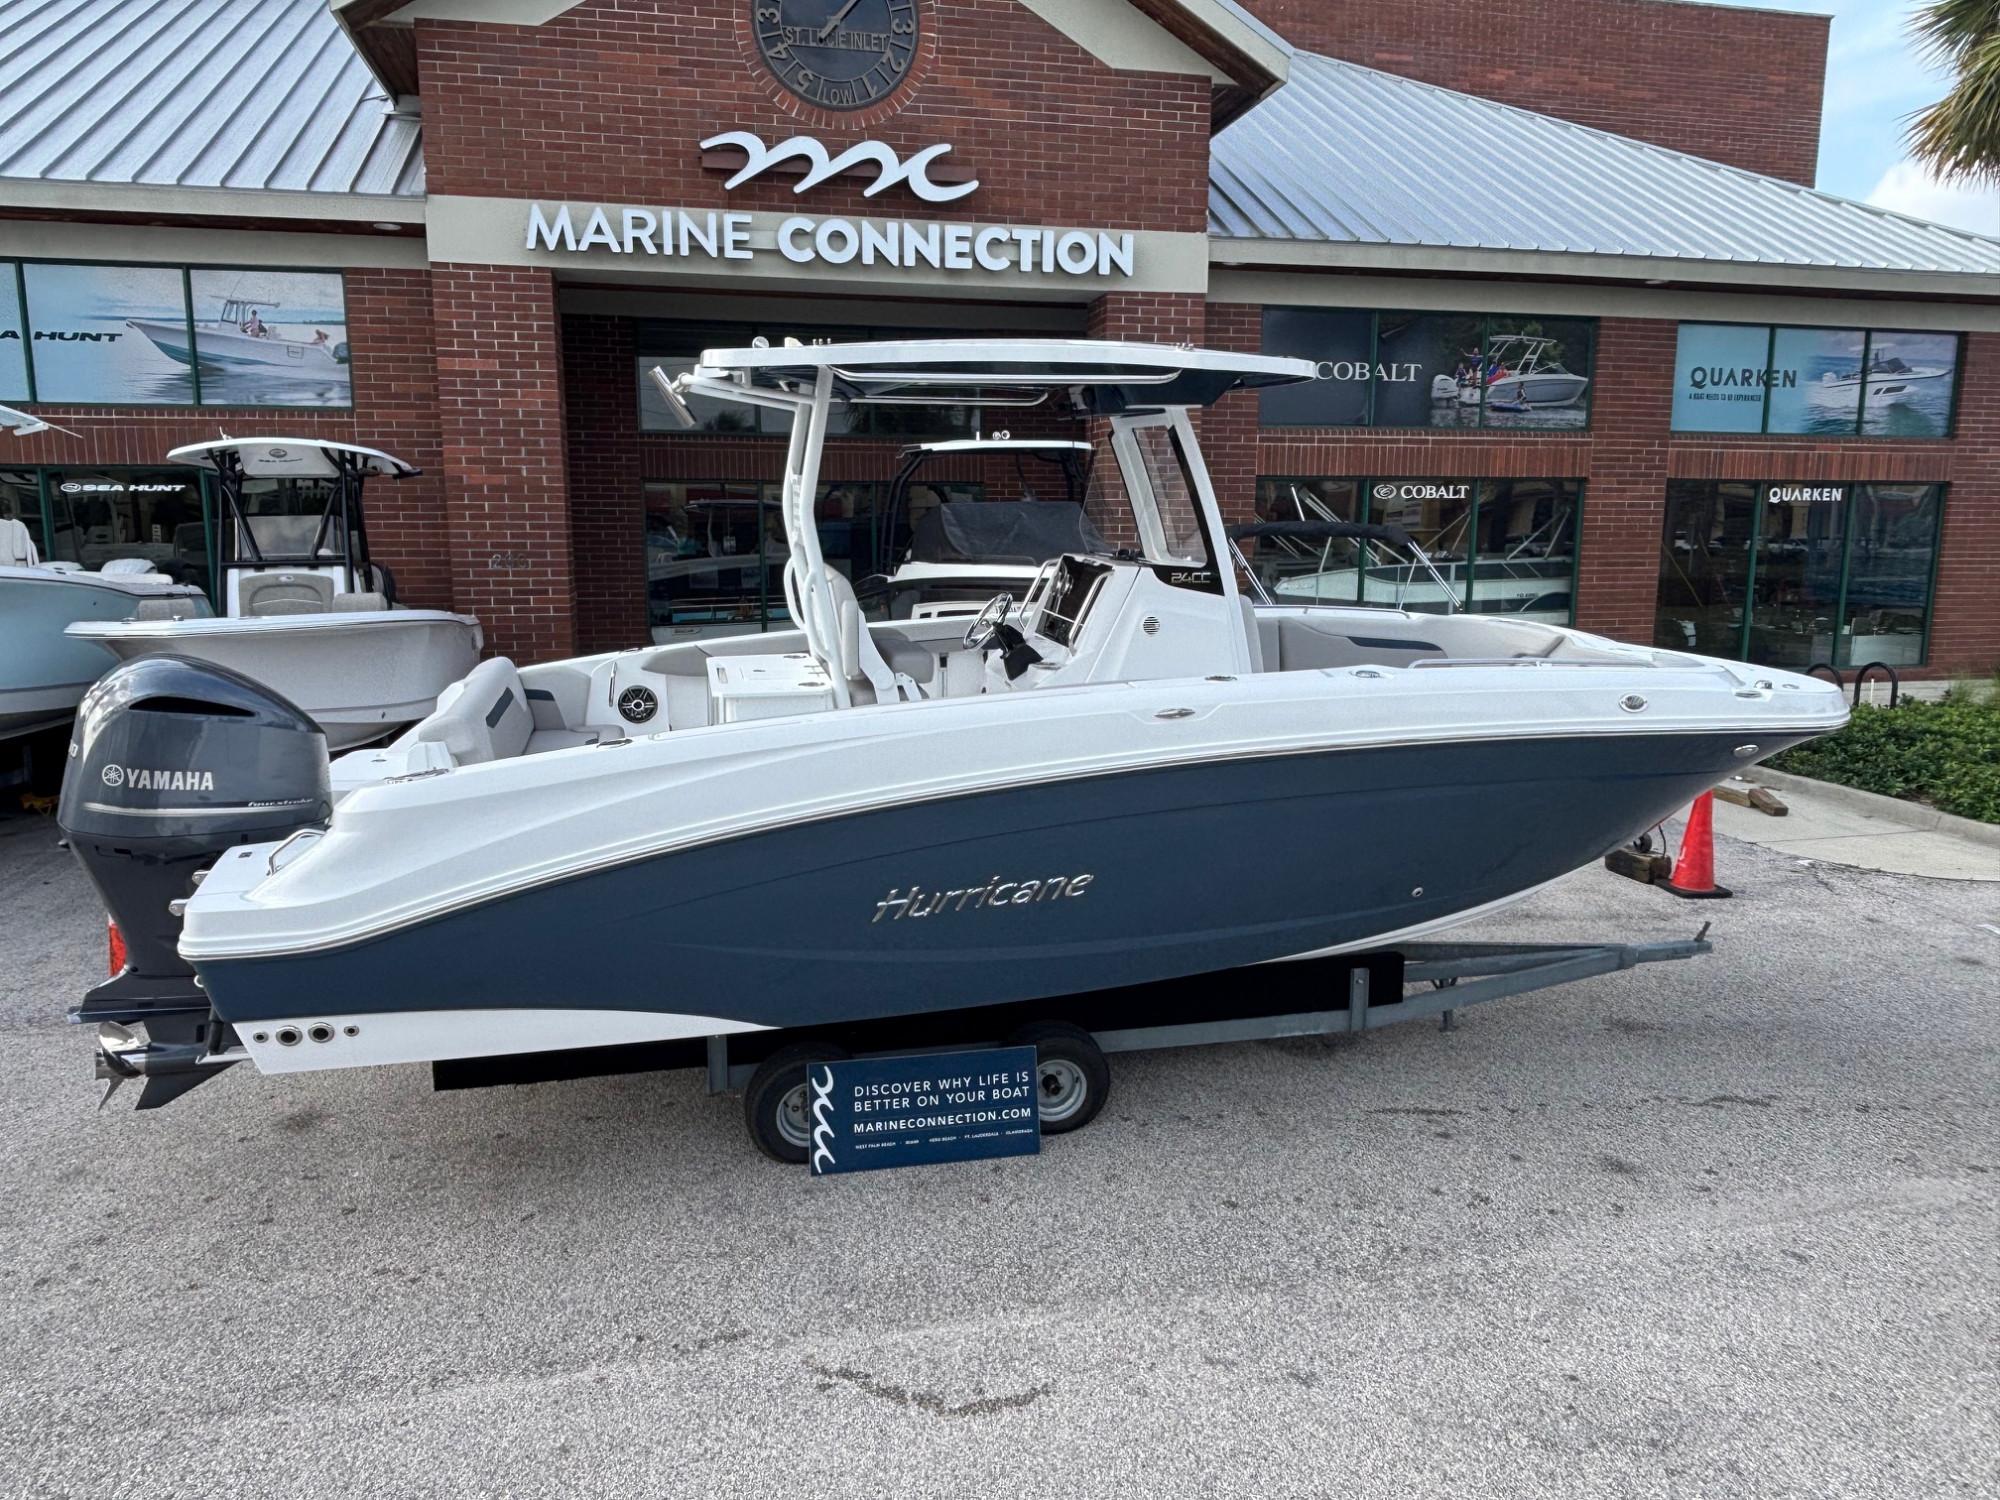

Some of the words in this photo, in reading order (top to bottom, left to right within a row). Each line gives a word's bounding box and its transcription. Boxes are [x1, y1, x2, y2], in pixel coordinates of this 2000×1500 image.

[849, 31, 888, 53] INLET
[823, 87, 852, 105] LOW
[526, 202, 754, 260] MARINE
[777, 216, 1135, 278] CONNECTION
[34, 331, 123, 342] HUNT
[1316, 361, 1423, 382] COBALT
[1690, 366, 1797, 389] QUARKEN
[82, 484, 125, 492] SEA
[129, 484, 187, 492] HUNT
[1400, 485, 1470, 499] COBALT
[1768, 487, 1843, 503] QUARKEN
[127, 768, 214, 791] YAMAHA
[871, 874, 1095, 923] Hurricane
[854, 1080, 931, 1097] DISCOVER
[938, 1076, 972, 1090] WHY
[979, 1073, 1009, 1086] LIFE
[1016, 1071, 1029, 1082] IS
[854, 1097, 910, 1112] BETTER
[917, 1095, 939, 1107] ON
[946, 1090, 986, 1104] YOUR
[992, 1086, 1030, 1100] BOAT
[854, 1107, 1031, 1133] MARINECONNECTION.COM
